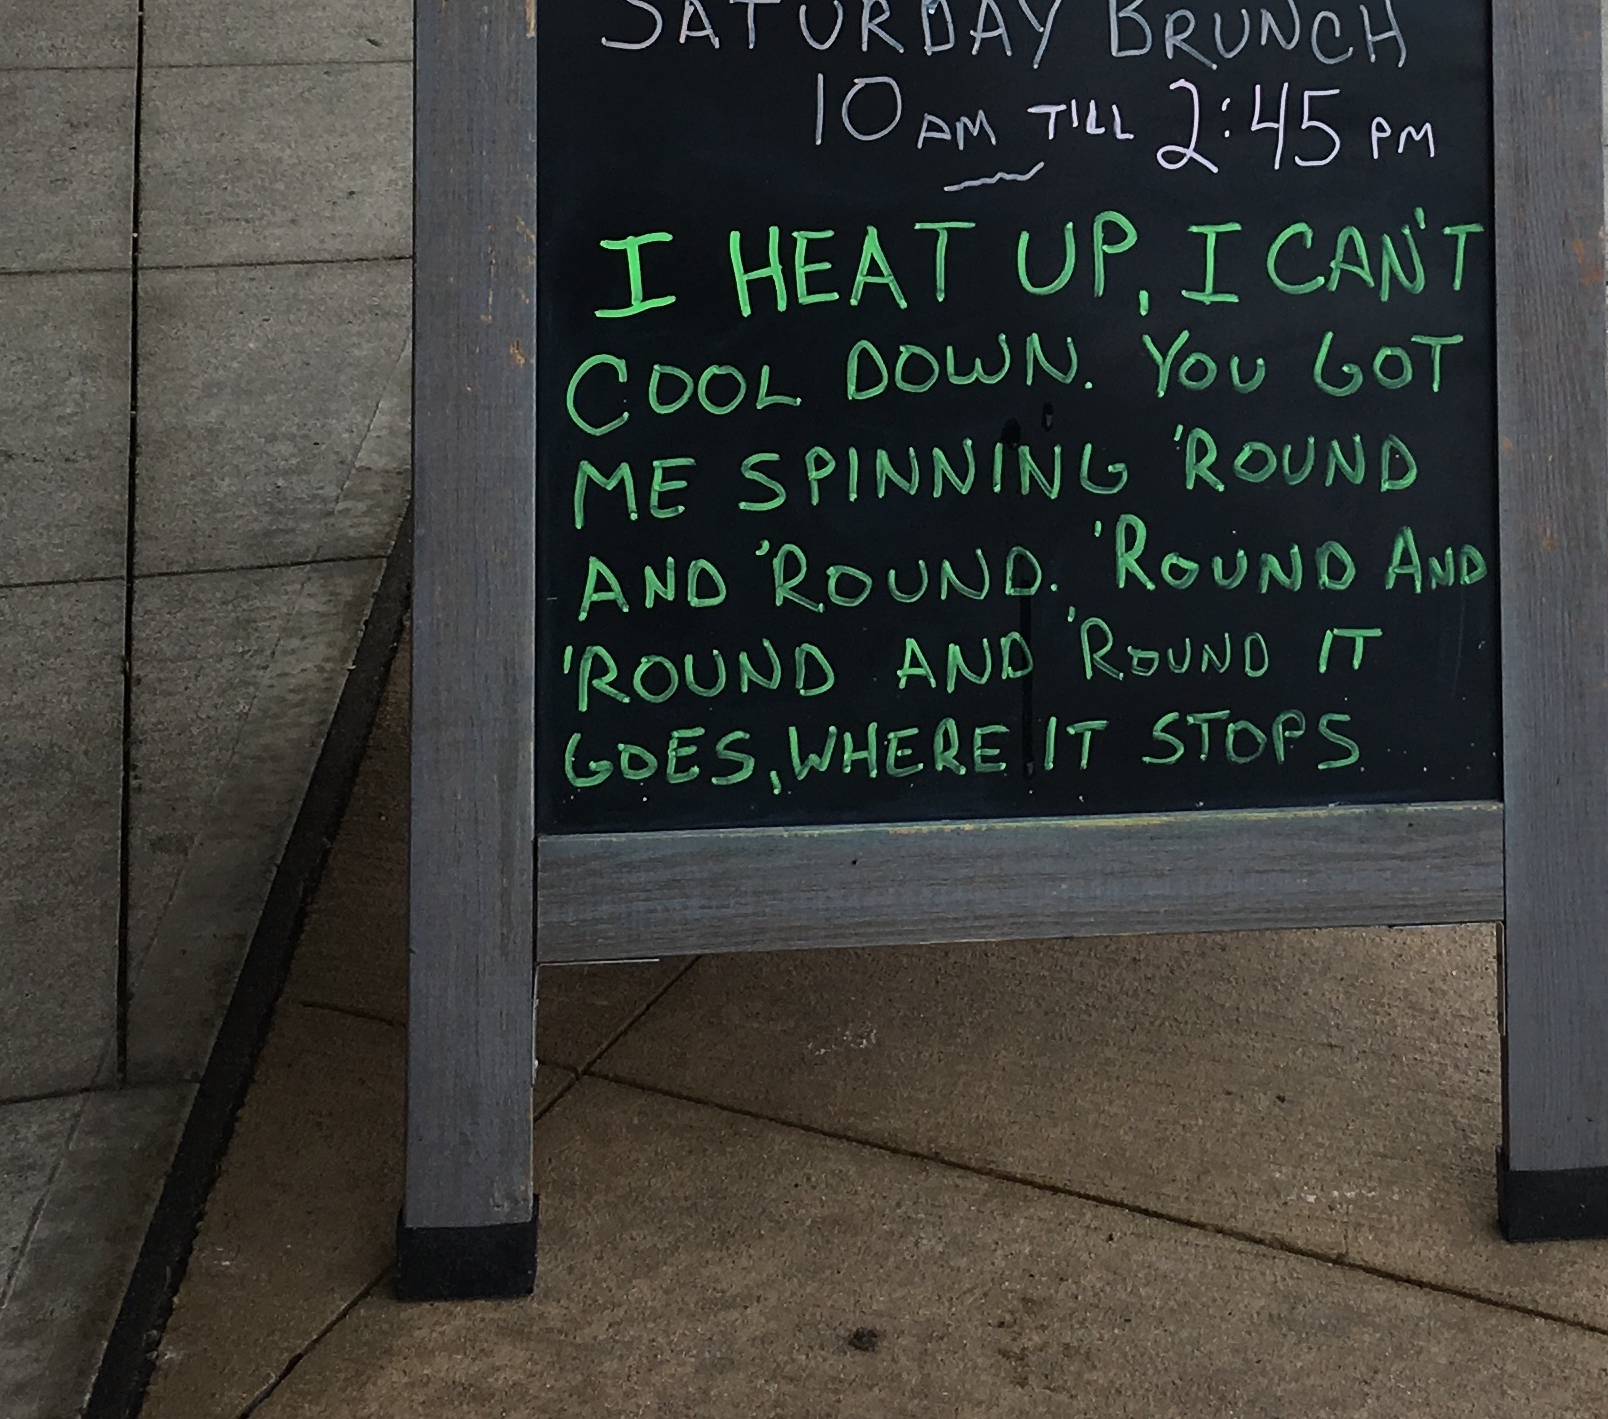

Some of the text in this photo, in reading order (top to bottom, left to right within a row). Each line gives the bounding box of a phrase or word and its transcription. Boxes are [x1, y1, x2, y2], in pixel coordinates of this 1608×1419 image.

[814, 72, 1436, 174] 10 AM TILL 2:45 PM
[594, 206, 1485, 318] I HEAT UP, I CAN'T
[566, 329, 1464, 436] COOL DOWN. YOU GOT
[573, 423, 1418, 530] ME SPINNING 'ROUND
[577, 513, 1488, 622] AND 'ROUND. 'ROUND AND
[563, 605, 1384, 713] 'ROUND AND 'ROUND IT
[787, 717, 1010, 781] WHERE
[1044, 715, 1111, 771] IT
[1141, 708, 1361, 771] STOPS
